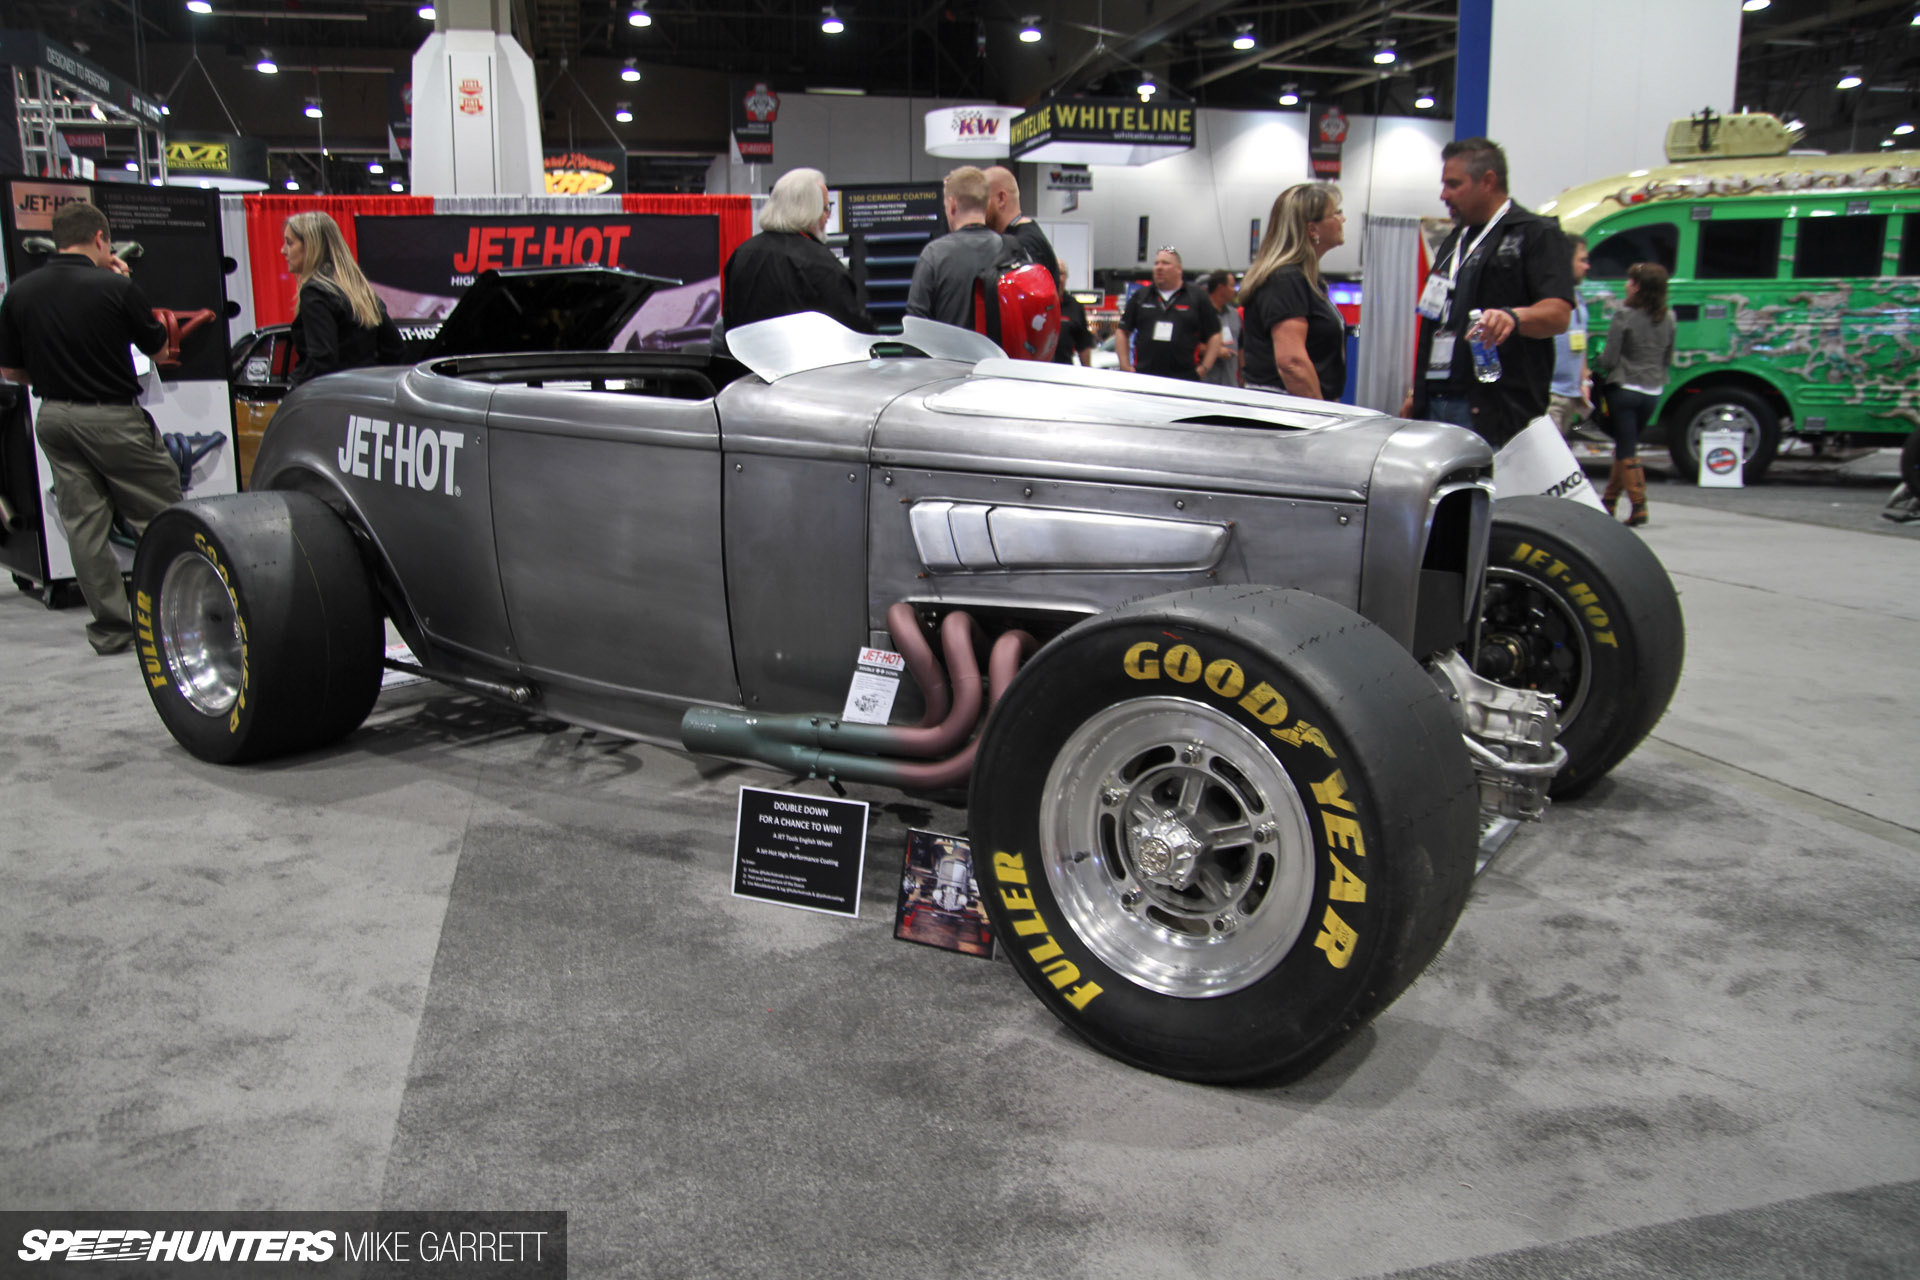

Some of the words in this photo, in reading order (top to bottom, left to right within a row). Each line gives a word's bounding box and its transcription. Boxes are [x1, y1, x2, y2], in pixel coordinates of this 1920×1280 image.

[46, 46, 76, 76] DESIGNED
[76, 62, 85, 80] TO
[84, 67, 110, 94] PERFORM
[958, 117, 1000, 136] KW
[1010, 106, 1051, 146] WHITELINE
[1056, 104, 1192, 132] WHITELINE
[866, 193, 901, 202] CERAMIC
[903, 191, 937, 201] COATING
[453, 226, 631, 273] JET-HOT
[338, 414, 464, 496] JET-HOT
[1509, 542, 1619, 649] JET-HOT
[137, 590, 168, 689] FULLER
[863, 650, 902, 666] JET-HOT
[773, 801, 803, 814] DOUBLE
[803, 805, 829, 817] DOWN
[758, 814, 774, 825] FOR
[774, 816, 780, 825] A
[780, 817, 810, 831] CHANCE
[811, 821, 822, 832] TO
[823, 823, 842, 835] WIN!
[786, 834, 799, 843] Tools
[799, 836, 816, 846] English
[816, 838, 833, 848] Wheel
[777, 850, 789, 860] High
[789, 852, 819, 864] Performance
[819, 856, 839, 867] Coating
[993, 851, 1104, 1011] FULLER
